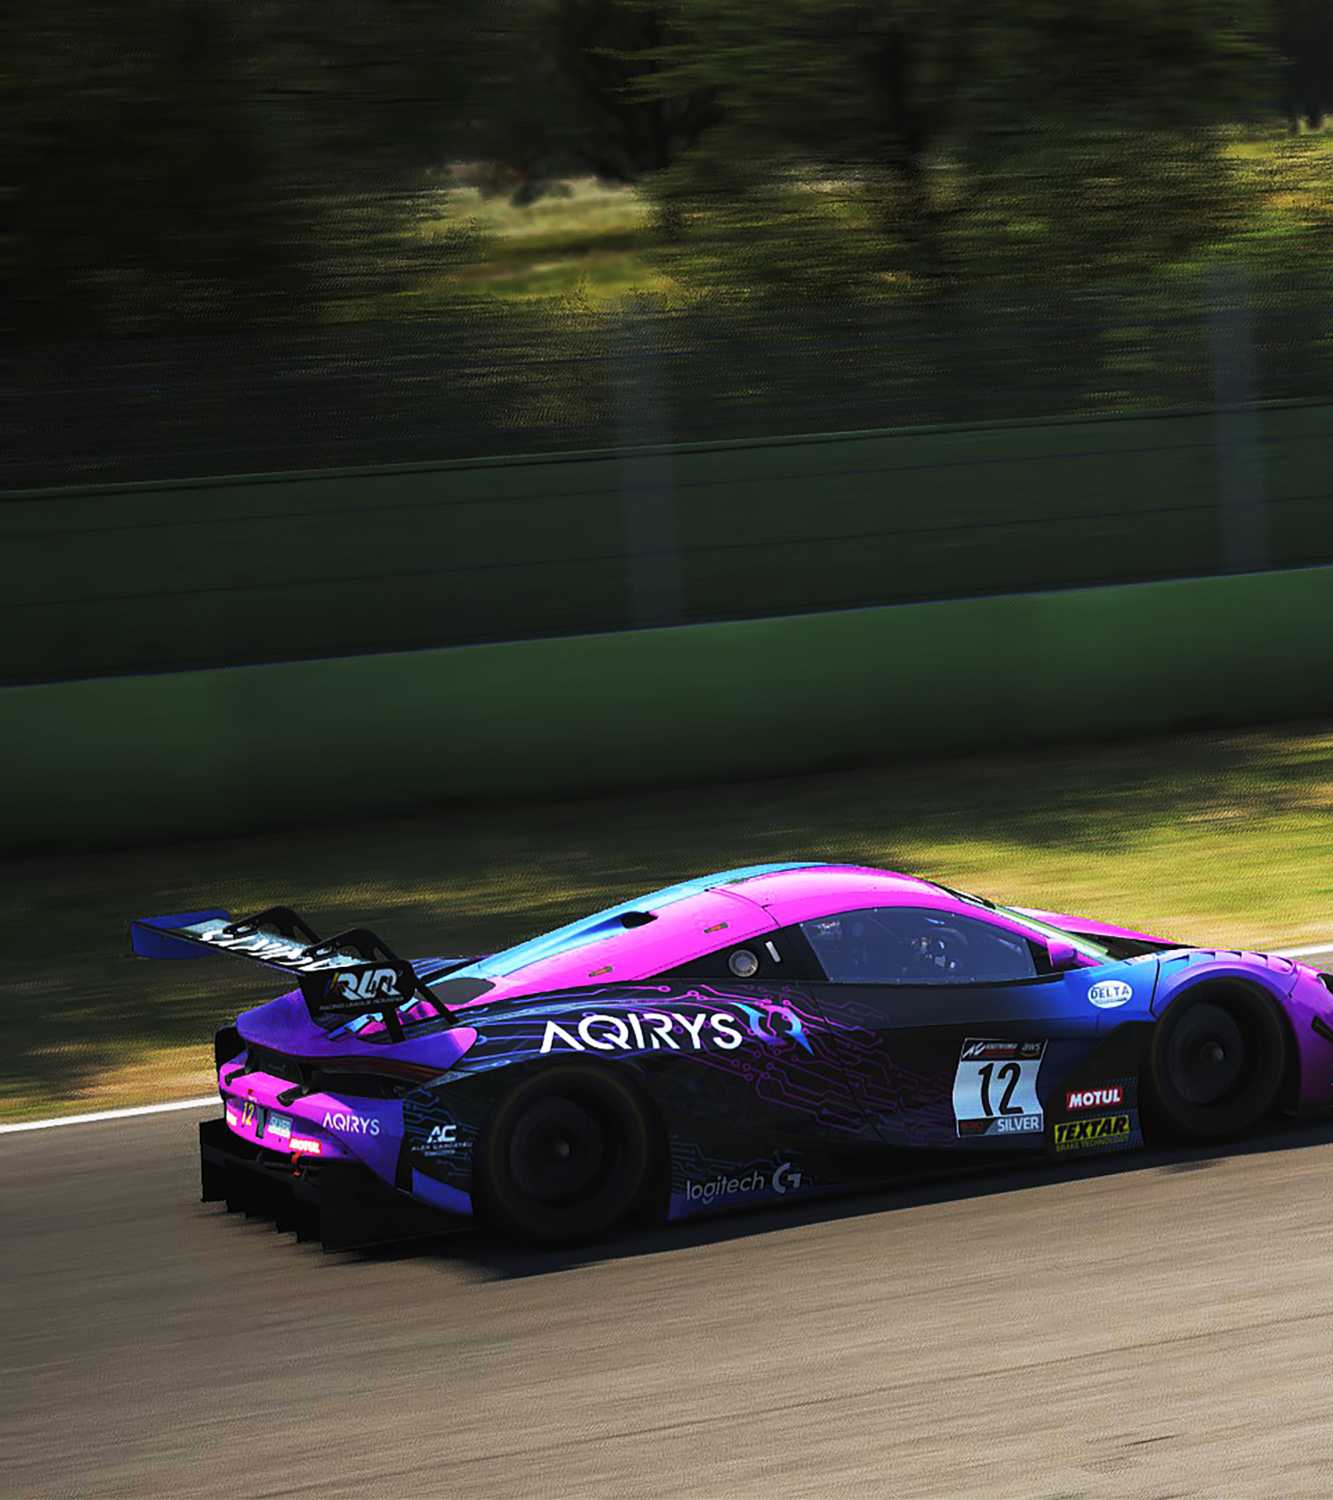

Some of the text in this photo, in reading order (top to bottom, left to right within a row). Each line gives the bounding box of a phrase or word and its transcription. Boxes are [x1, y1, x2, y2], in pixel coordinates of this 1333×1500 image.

[1090, 985, 1130, 999] DELTA
[539, 1013, 743, 1054] AQIRYS
[978, 1062, 1024, 1117] 12
[1069, 1089, 1121, 1108] MOTUL
[241, 1102, 254, 1127] 12
[323, 1111, 380, 1136] AQIRYS
[997, 1116, 1040, 1132] SILVER
[1056, 1115, 1128, 1144] TEXTAR
[686, 1170, 765, 1204] logitech
